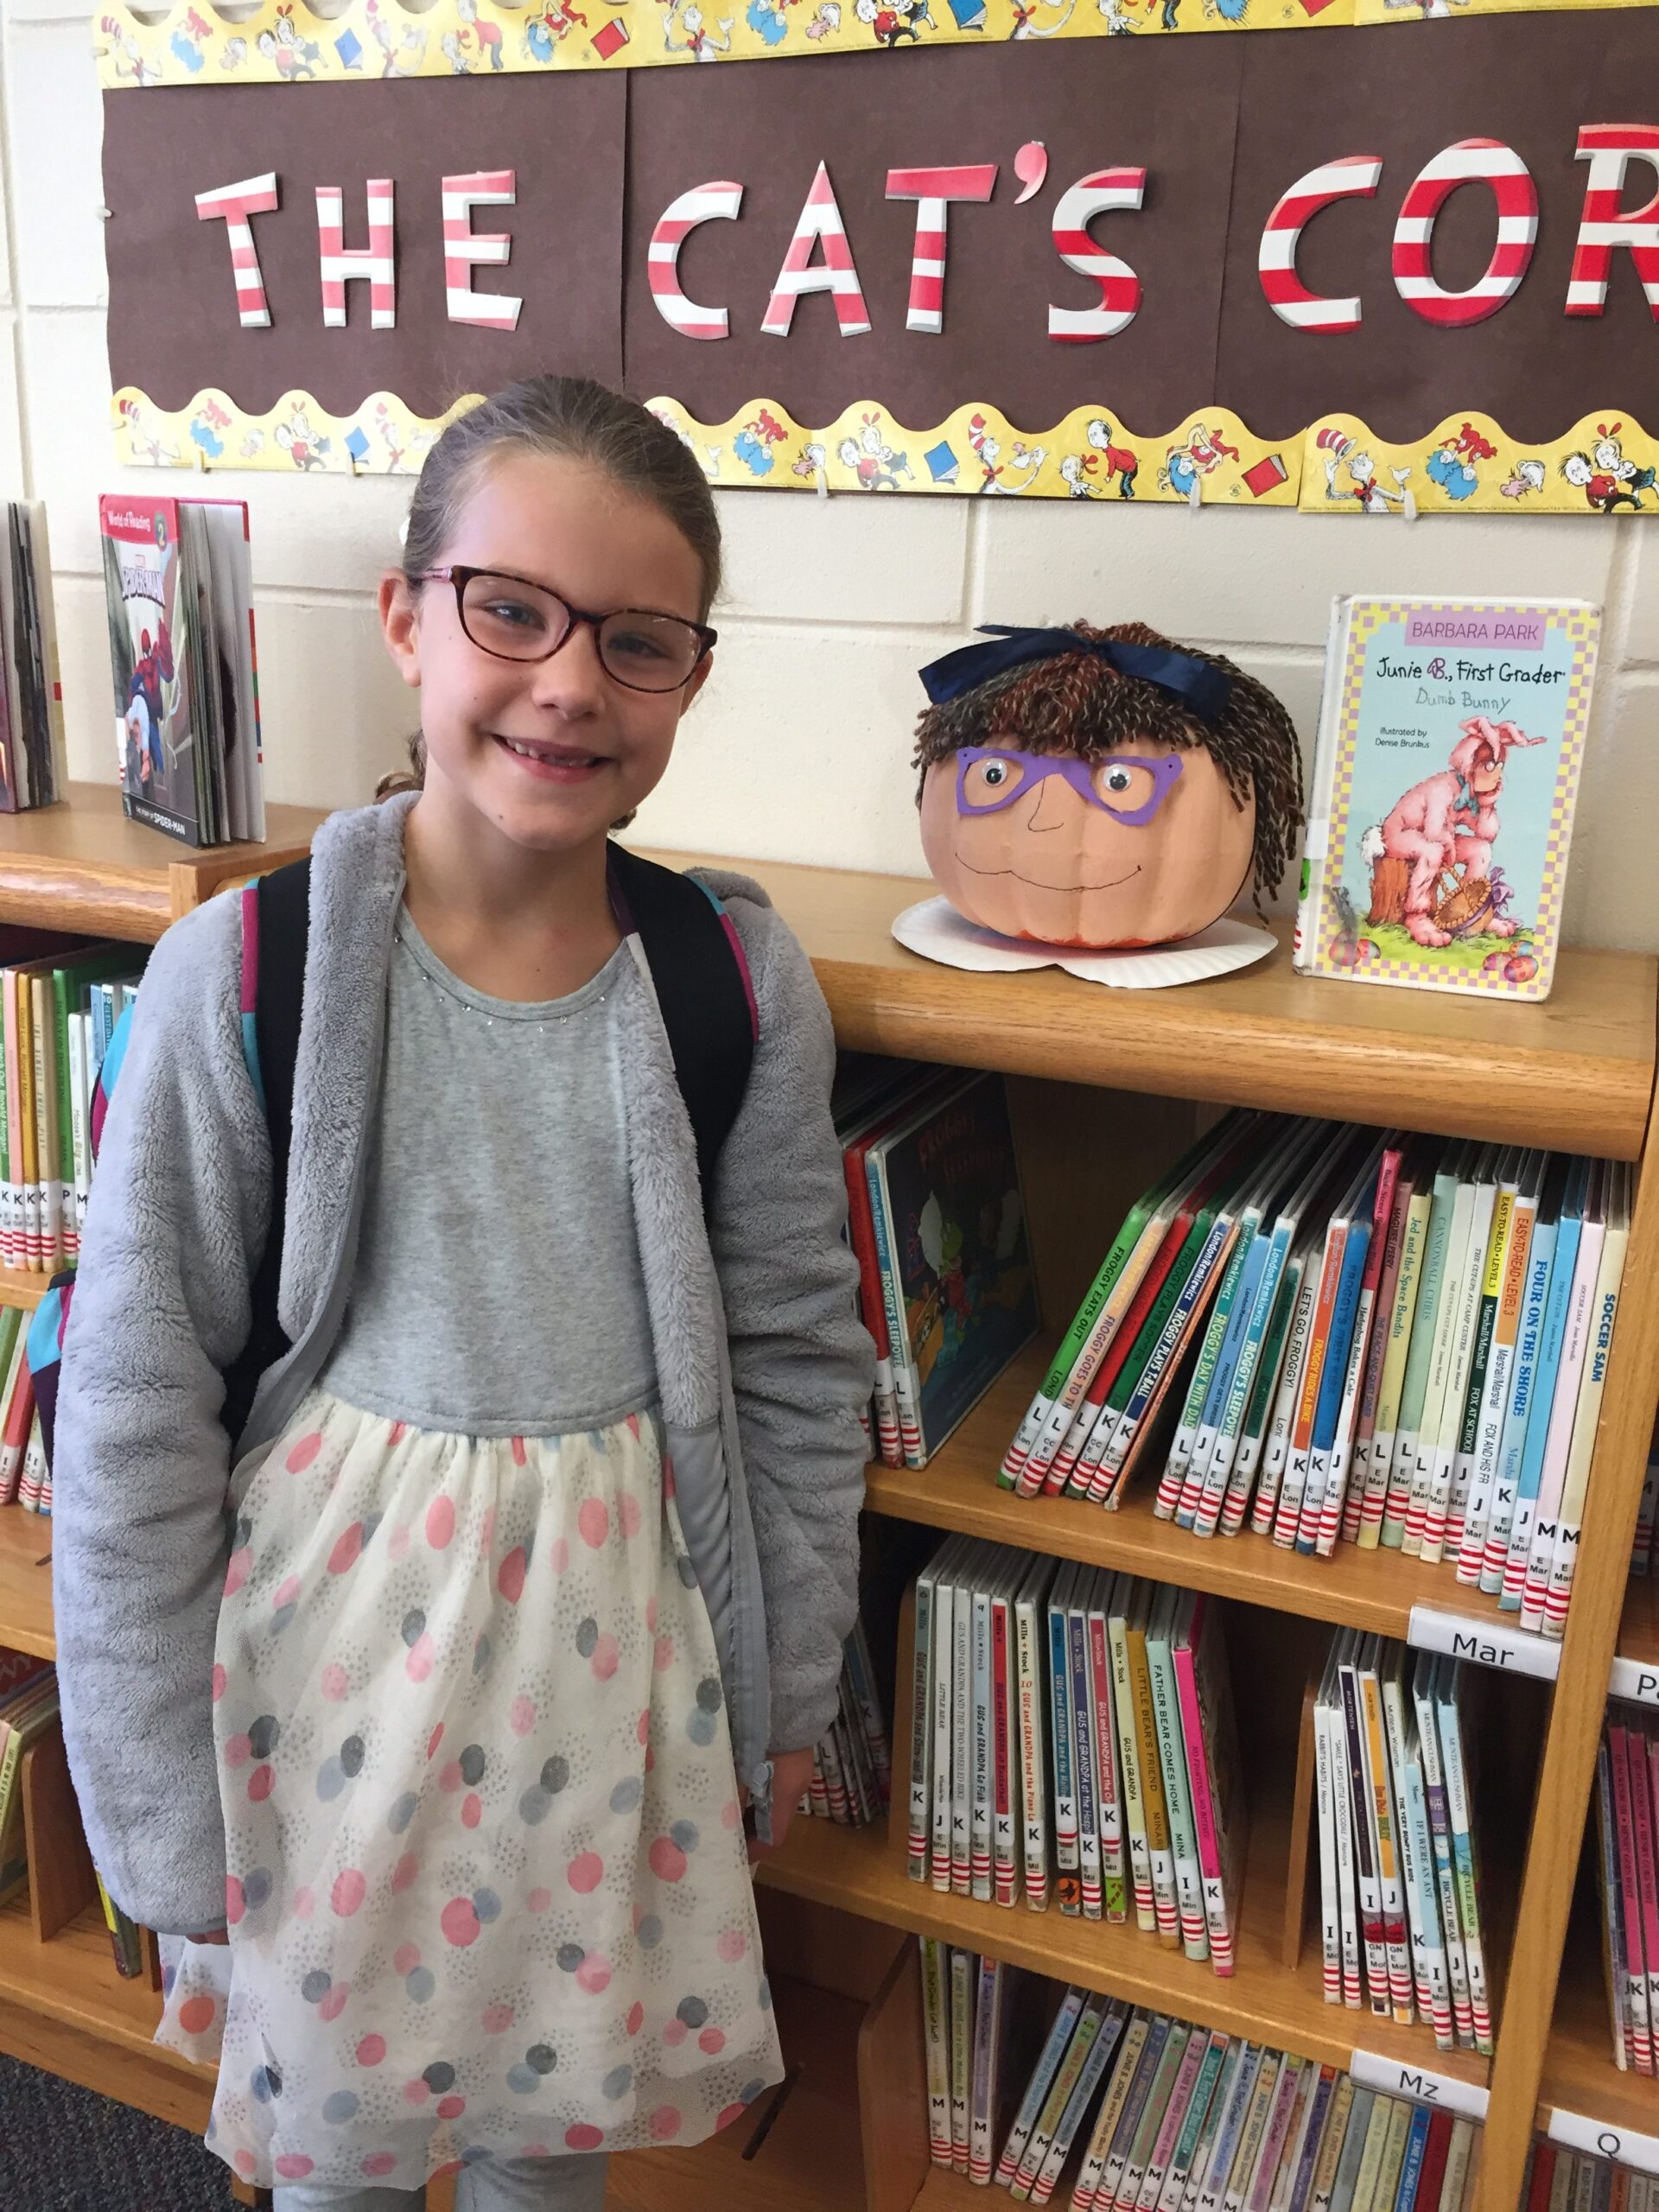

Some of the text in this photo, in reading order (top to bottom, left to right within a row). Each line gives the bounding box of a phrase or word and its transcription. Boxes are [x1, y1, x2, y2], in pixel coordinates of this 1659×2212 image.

[194, 170, 523, 331] THE
[648, 140, 1147, 343] CAT'S
[107, 511, 123, 526] World
[130, 511, 151, 532] Reading
[158, 523, 165, 546] 2
[1412, 622, 1539, 640] BARBARA PARK
[1376, 657, 1422, 678] Junie
[1456, 660, 1494, 681] First
[1499, 663, 1565, 684] Grader
[1415, 687, 1510, 715] Dumb Bunny
[1376, 738, 1429, 748] Denise Brunkus
[1418, 729, 1427, 738] by
[154, 812, 186, 836] SPIDER-MAN
[3, 1191, 9, 1202] K
[27, 1193, 35, 1205] K
[62, 1190, 70, 1200] P
[78, 1193, 87, 1205] M
[1493, 1195, 1510, 1252] EASY-TO-READ
[1472, 1247, 1481, 1262] THE
[1508, 1217, 1527, 1277] EASY-TO-READ
[1182, 1230, 1225, 1302] London/Remkiewicz
[1421, 1216, 1446, 1321] CANNONBALL CHRIS
[1489, 1257, 1500, 1281] LEVEL
[1391, 1217, 1421, 1338] Jed and the Space Bandits
[1468, 1263, 1478, 1292] CUT-UPS
[1529, 1259, 1548, 1303] FOUR
[1466, 1293, 1473, 1303] AT
[1503, 1282, 1517, 1307] LEVEL
[1463, 1303, 1471, 1323] CAMP
[1525, 1306, 1540, 1328] ON
[1161, 1307, 1187, 1344] FROGGY
[1182, 1221, 1254, 1428] London/Remkiewicz FROGGY'S DAY WITH DAD
[1353, 1306, 1368, 1344] Hedgehog
[1284, 1286, 1312, 1388] LET'S GO, FROGGY!
[1459, 1324, 1469, 1351] CUSTER
[1474, 1303, 1493, 1369] Marshall/Marshall
[1520, 1329, 1536, 1362] THE
[1590, 1293, 1616, 1382] SOCCER SAM
[1149, 1344, 1170, 1371] PLAYS
[1350, 1346, 1361, 1369] Bakes
[1136, 1370, 1158, 1399] T-BALL
[1344, 1377, 1355, 1396] Cake
[1452, 1371, 1461, 1391] Marshall
[1489, 1349, 1508, 1409] Marshall/Marshall
[1469, 1387, 1480, 1406] FOX
[1511, 1364, 1531, 1417] SHORE
[1102, 1414, 1115, 1429] K
[1467, 1406, 1478, 1417] AT
[1052, 1417, 1060, 1431] L
[1462, 1417, 1476, 1453] SCHOOL
[1484, 1422, 1497, 1440] FOX
[1179, 1440, 1188, 1453] L
[1242, 1449, 1249, 1461] J
[1376, 1445, 1385, 1459] L
[1481, 1440, 1494, 1457] AND
[1294, 1458, 1306, 1472] K
[1478, 1458, 1491, 1471] HIS
[1368, 1478, 1384, 1486] Mar
[1282, 1493, 1299, 1503] Lon
[1498, 1488, 1511, 1503] K
[1465, 1529, 1482, 1538] Mar
[1538, 1522, 1556, 1538] M
[1562, 1529, 1580, 1544] M
[1453, 1633, 1515, 1666] Mar
[1114, 1641, 1125, 1683] Mills Stock
[1055, 1674, 1064, 1690] GUS
[1154, 1663, 1166, 1707] FATHER
[1637, 1674, 1659, 1700] P
[1345, 1690, 1355, 1729] MORTENSEN
[1056, 1707, 1066, 1743] GRANDPA
[1159, 1709, 1170, 1739] BEAR
[1058, 1745, 1066, 1758] and
[1097, 1701, 1112, 1791] GUS and GRANDPA and the
[1318, 1734, 1326, 1760] RABBIT'S
[1058, 1760, 1067, 1772] the
[1122, 1737, 1136, 1800] GUS and GRANDPA
[1163, 1742, 1175, 1781] COMES
[913, 1791, 923, 1803] K
[1168, 1783, 1179, 1815] HOME
[1411, 1784, 1420, 1803] Moses
[975, 1809, 985, 1821] K
[1414, 1819, 1424, 1830] IF
[1402, 1829, 1410, 1853] BUMPY
[1417, 1837, 1428, 1864] WERE
[1421, 1865, 1430, 1878] AN
[1182, 1878, 1189, 1889] I
[1208, 1886, 1219, 1897] K
[1422, 1880, 1433, 1900] ANT
[1461, 1864, 1472, 1903] BICYCLE
[1442, 1879, 1456, 1942] BICYCLE BEAR
[1465, 1904, 1475, 1926] BEAR
[1327, 1926, 1333, 1938] I
[1414, 1935, 1425, 1946] K
[1399, 2071, 1440, 2101] Mz
[933, 2098, 944, 2108] M
[1597, 2133, 1621, 2160] Q
[1090, 2160, 1102, 2171] M
[1148, 2169, 1161, 2180] M
